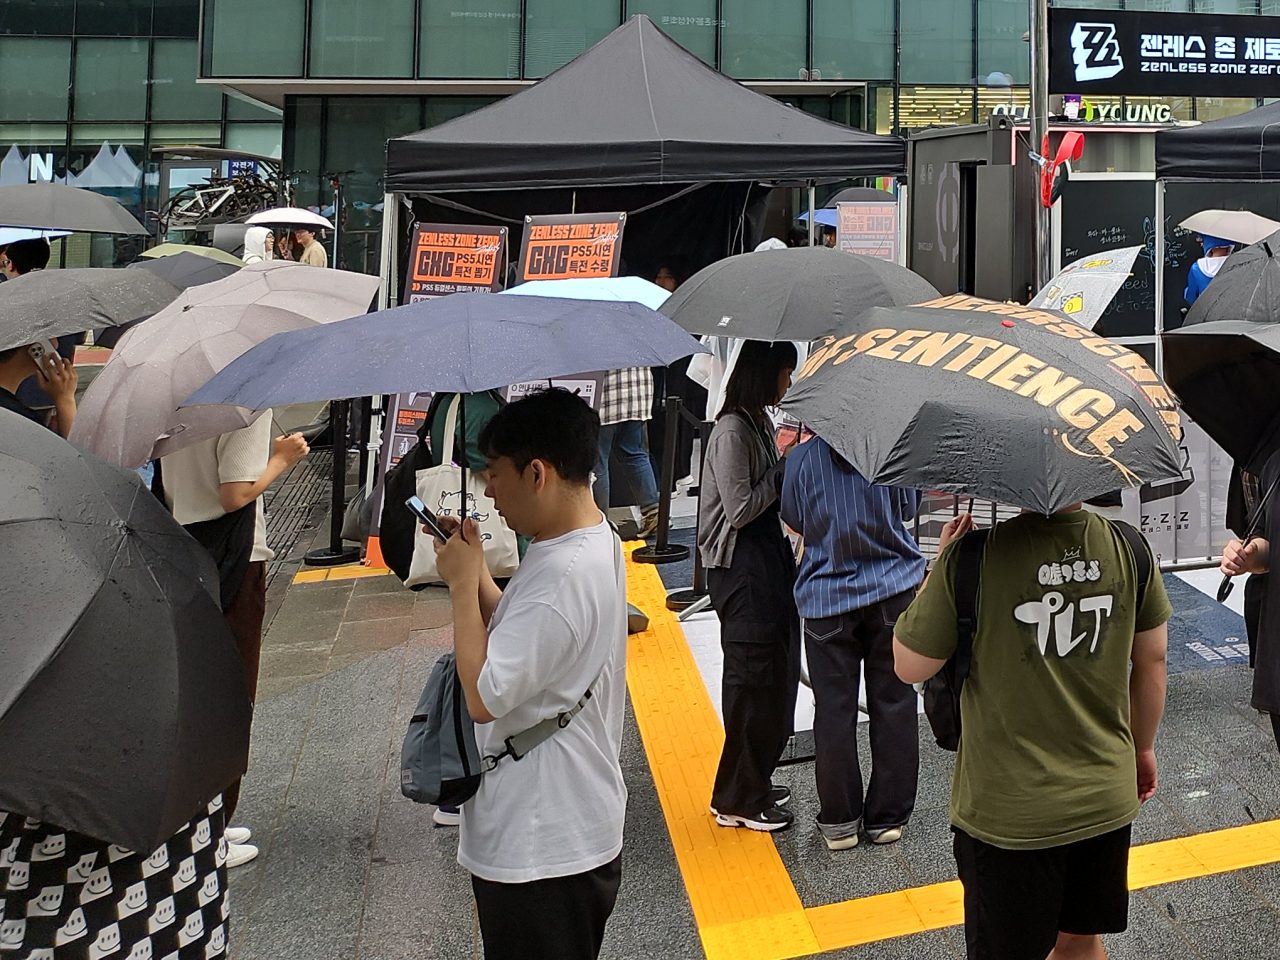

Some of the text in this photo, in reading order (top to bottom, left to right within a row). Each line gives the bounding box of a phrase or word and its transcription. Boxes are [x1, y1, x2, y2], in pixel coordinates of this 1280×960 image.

[1141, 34, 1206, 59] 젠레스
[1215, 36, 1236, 59] 존
[1096, 103, 1172, 122] YOUNG
[232, 161, 254, 169] 자전거
[418, 231, 455, 246] ZENLESS
[455, 234, 478, 247] ZONE
[530, 224, 570, 240] ZENLESS
[569, 223, 594, 239] ZONE
[455, 266, 492, 280] 특전 뽑기
[569, 258, 609, 274] 특전 수령
[422, 283, 434, 292] PS5
[833, 328, 1145, 456] SENTIENCE
